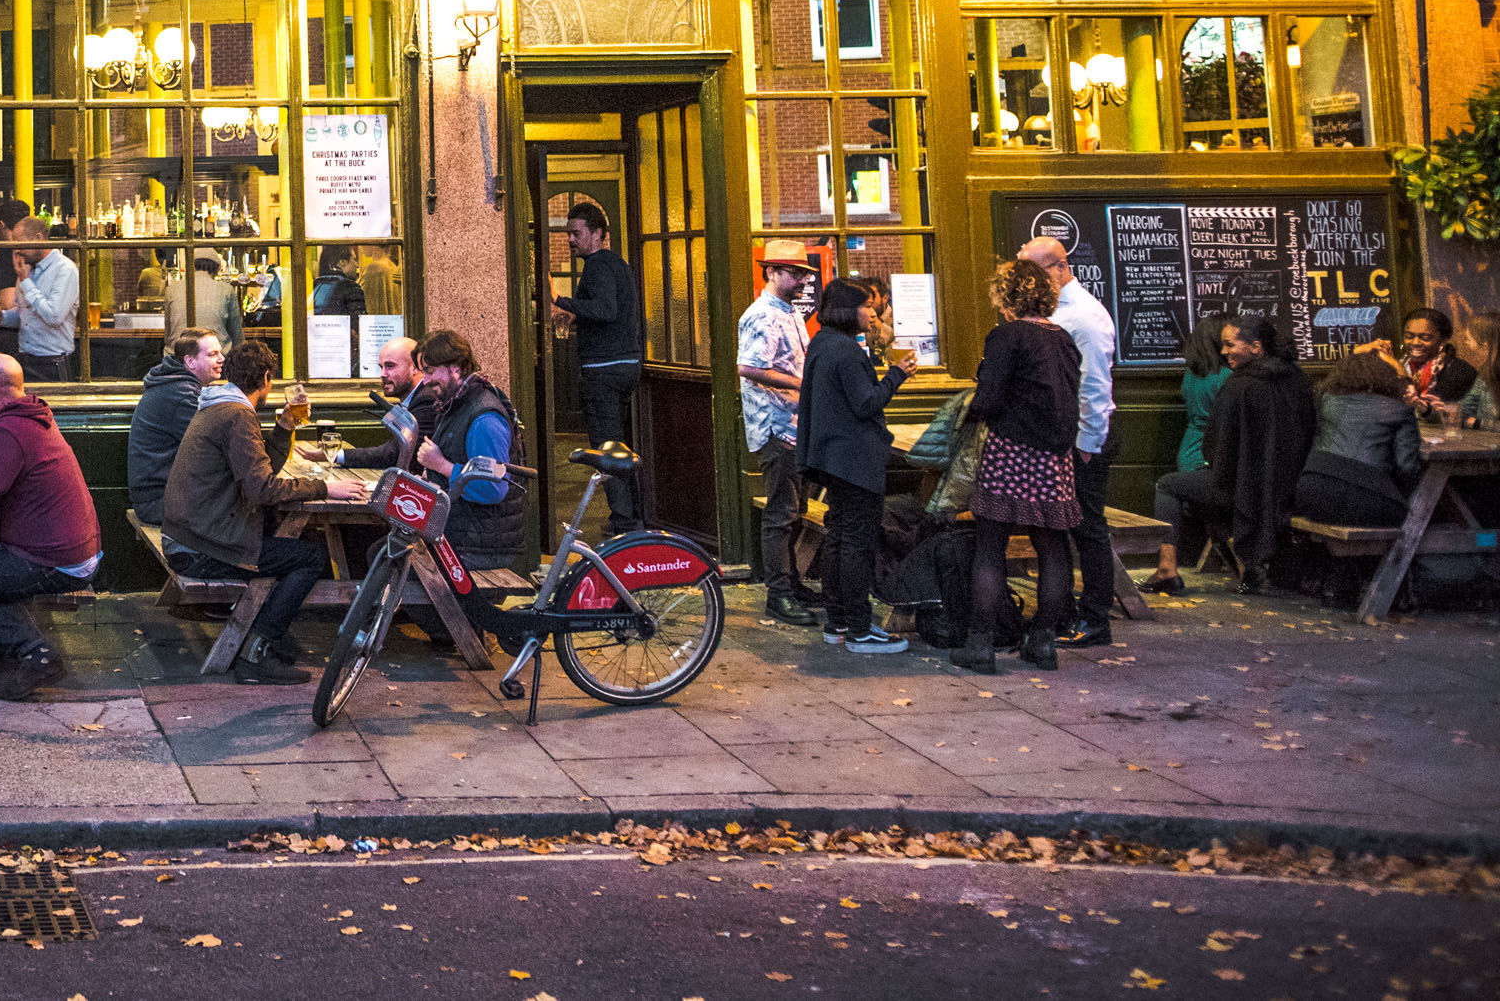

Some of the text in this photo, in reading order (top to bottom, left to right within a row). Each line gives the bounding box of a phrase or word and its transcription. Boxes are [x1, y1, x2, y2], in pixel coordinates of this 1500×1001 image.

[352, 150, 378, 158] PARTIES
[1346, 201, 1362, 216] GO
[1116, 215, 1163, 230] EMERGING
[1191, 218, 1265, 230] MOVIE MONDAY'S
[1308, 217, 1362, 232] CHASING
[1117, 232, 1179, 246] FILMMAKERS
[1192, 232, 1214, 242] EVERY
[1217, 233, 1238, 243] WEEK
[1303, 231, 1385, 249] WATERFALLS!
[1118, 248, 1151, 261] NIGHT
[1191, 248, 1278, 260] QUIZ NIGHT TUES
[1314, 250, 1377, 266] JOIN THE
[1223, 260, 1252, 269] START
[1078, 265, 1102, 281] FOOD
[1196, 283, 1225, 295] VINYL
[1290, 303, 1304, 317] US
[1328, 326, 1374, 344] EVERY
[404, 484, 432, 502] Santander
[636, 558, 691, 574] Santander
